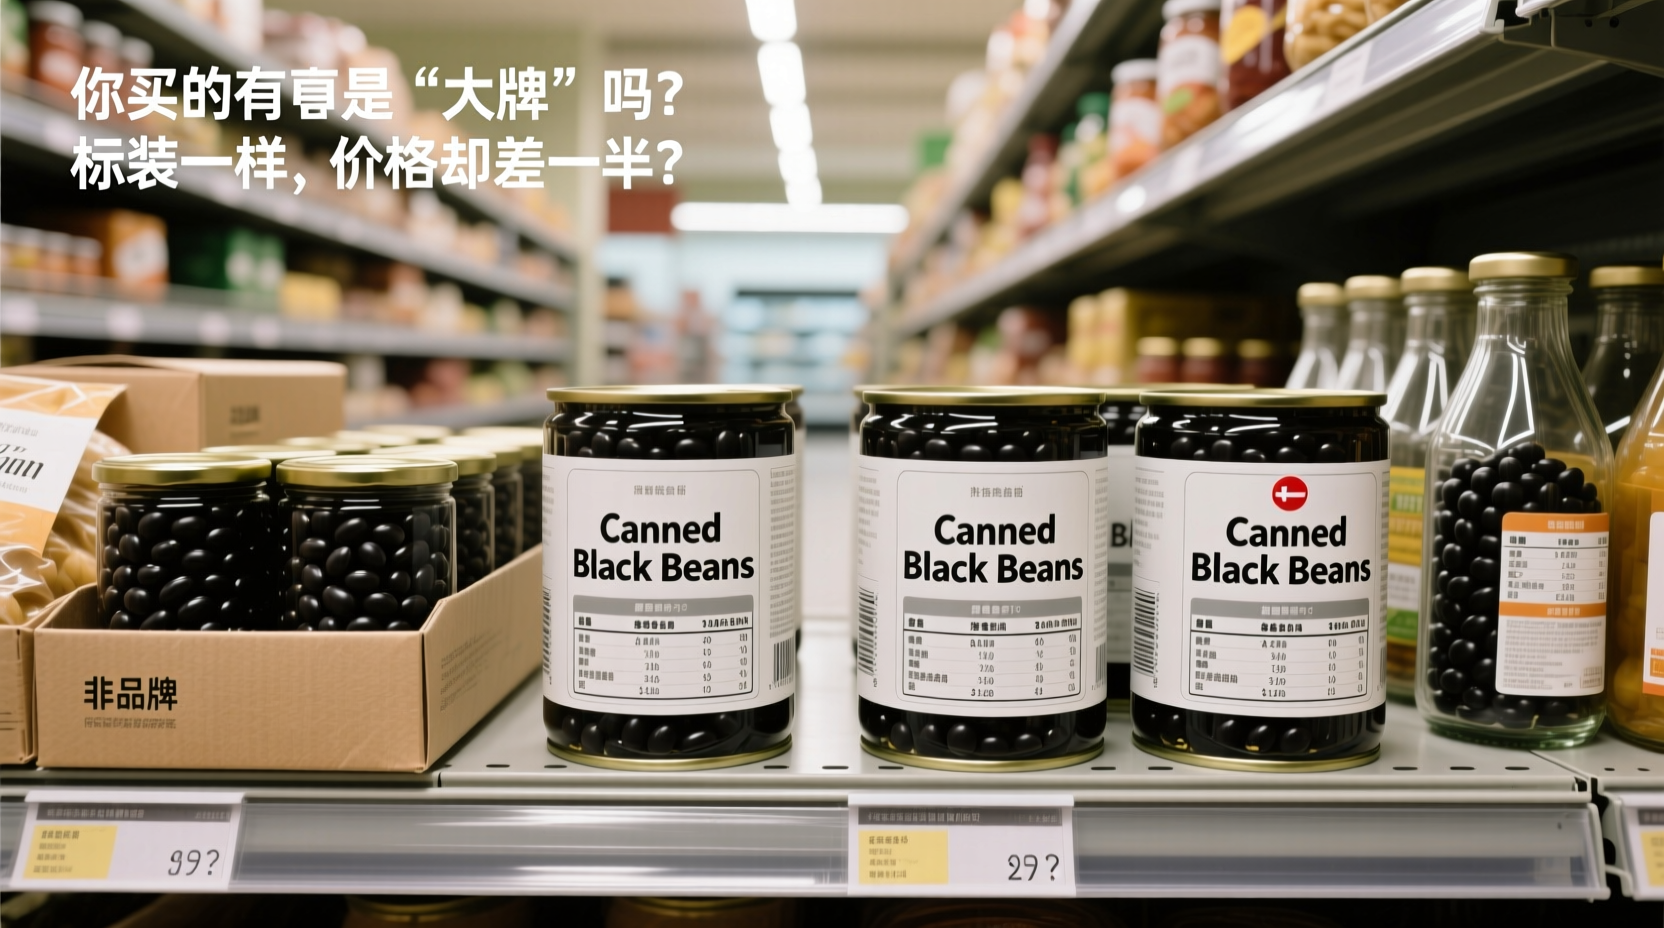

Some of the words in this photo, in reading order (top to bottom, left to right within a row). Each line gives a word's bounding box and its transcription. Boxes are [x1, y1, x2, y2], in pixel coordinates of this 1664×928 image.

[600, 512, 721, 543] Canned
[934, 513, 1056, 546] Canned
[1226, 515, 1347, 548] Canned
[573, 548, 653, 582] Black
[661, 552, 755, 582] Beans
[903, 550, 988, 584] Black
[997, 553, 1084, 584] Beans
[1191, 551, 1280, 585] Black
[1288, 555, 1371, 585] Beans
[83, 675, 178, 711] 非品牌
[1007, 853, 1060, 881] 29?
